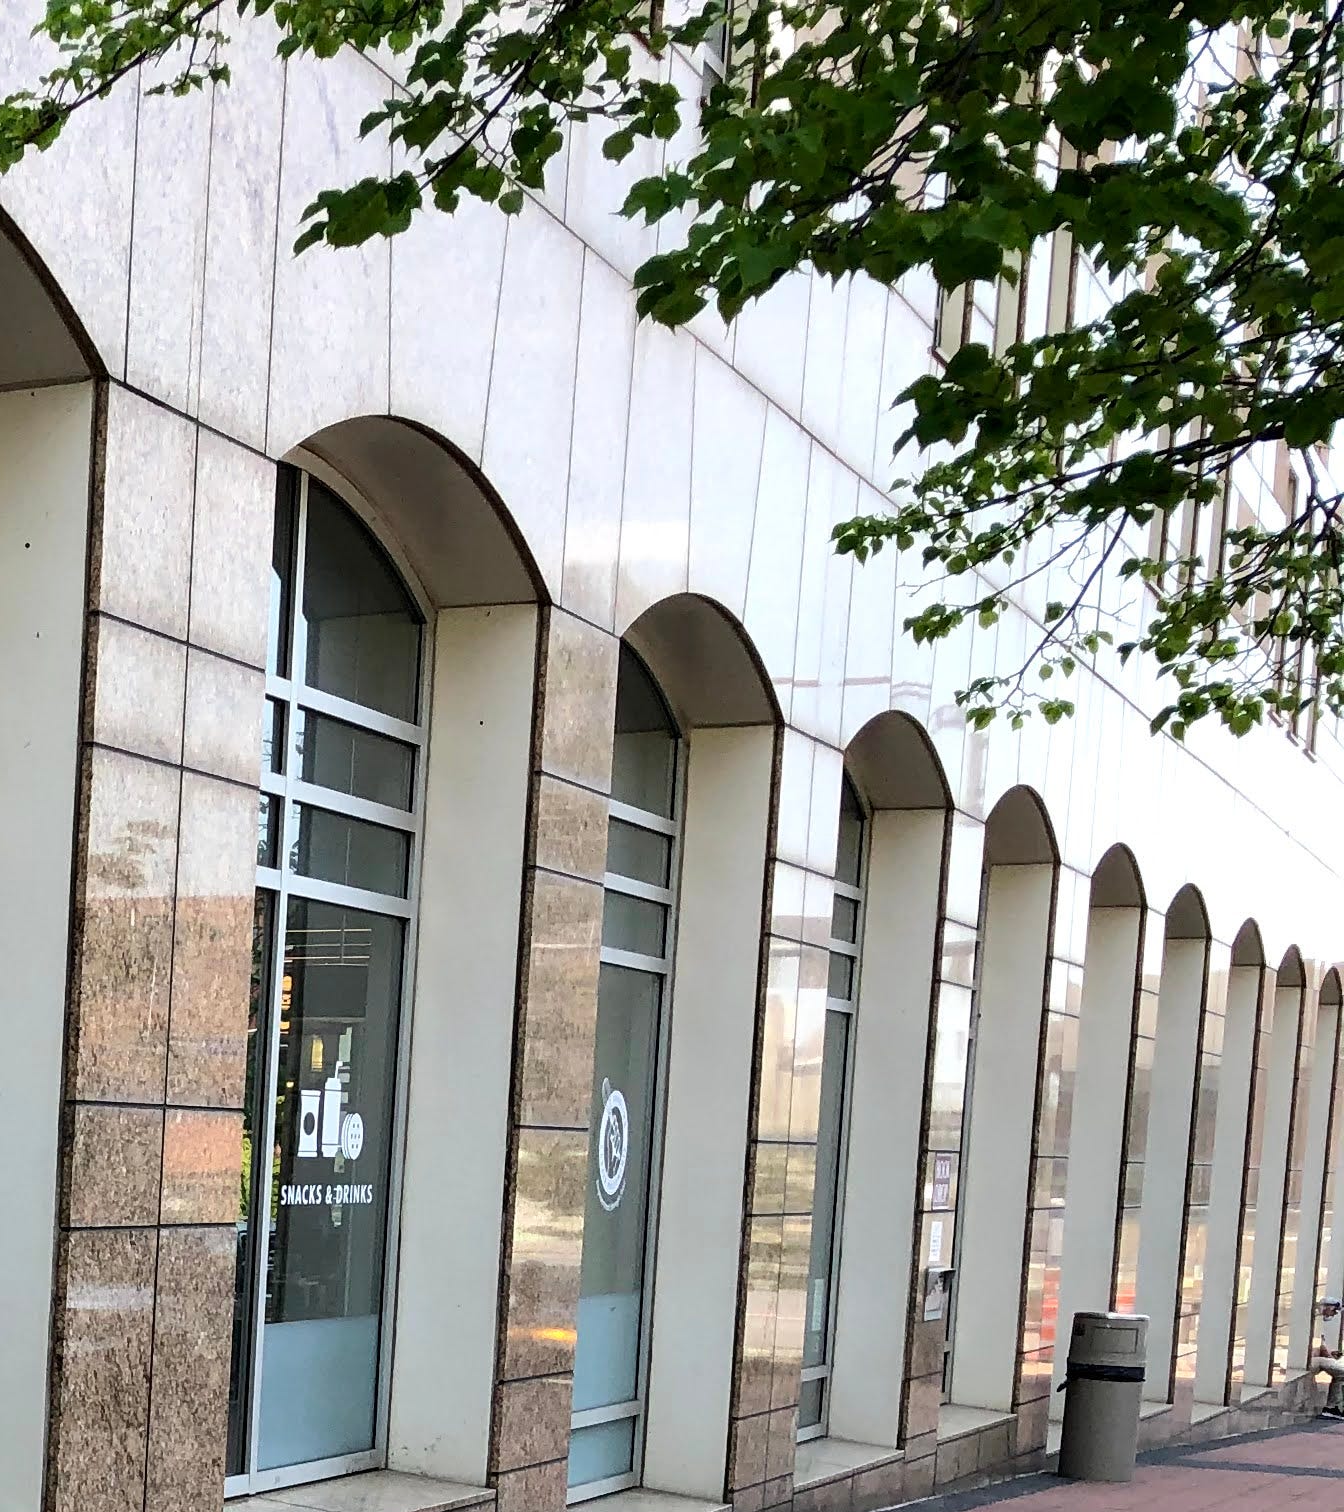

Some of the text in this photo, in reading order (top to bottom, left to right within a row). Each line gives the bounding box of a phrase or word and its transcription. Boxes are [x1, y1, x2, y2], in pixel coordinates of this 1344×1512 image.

[280, 1184, 373, 1205] SNACKS & DRINKS
